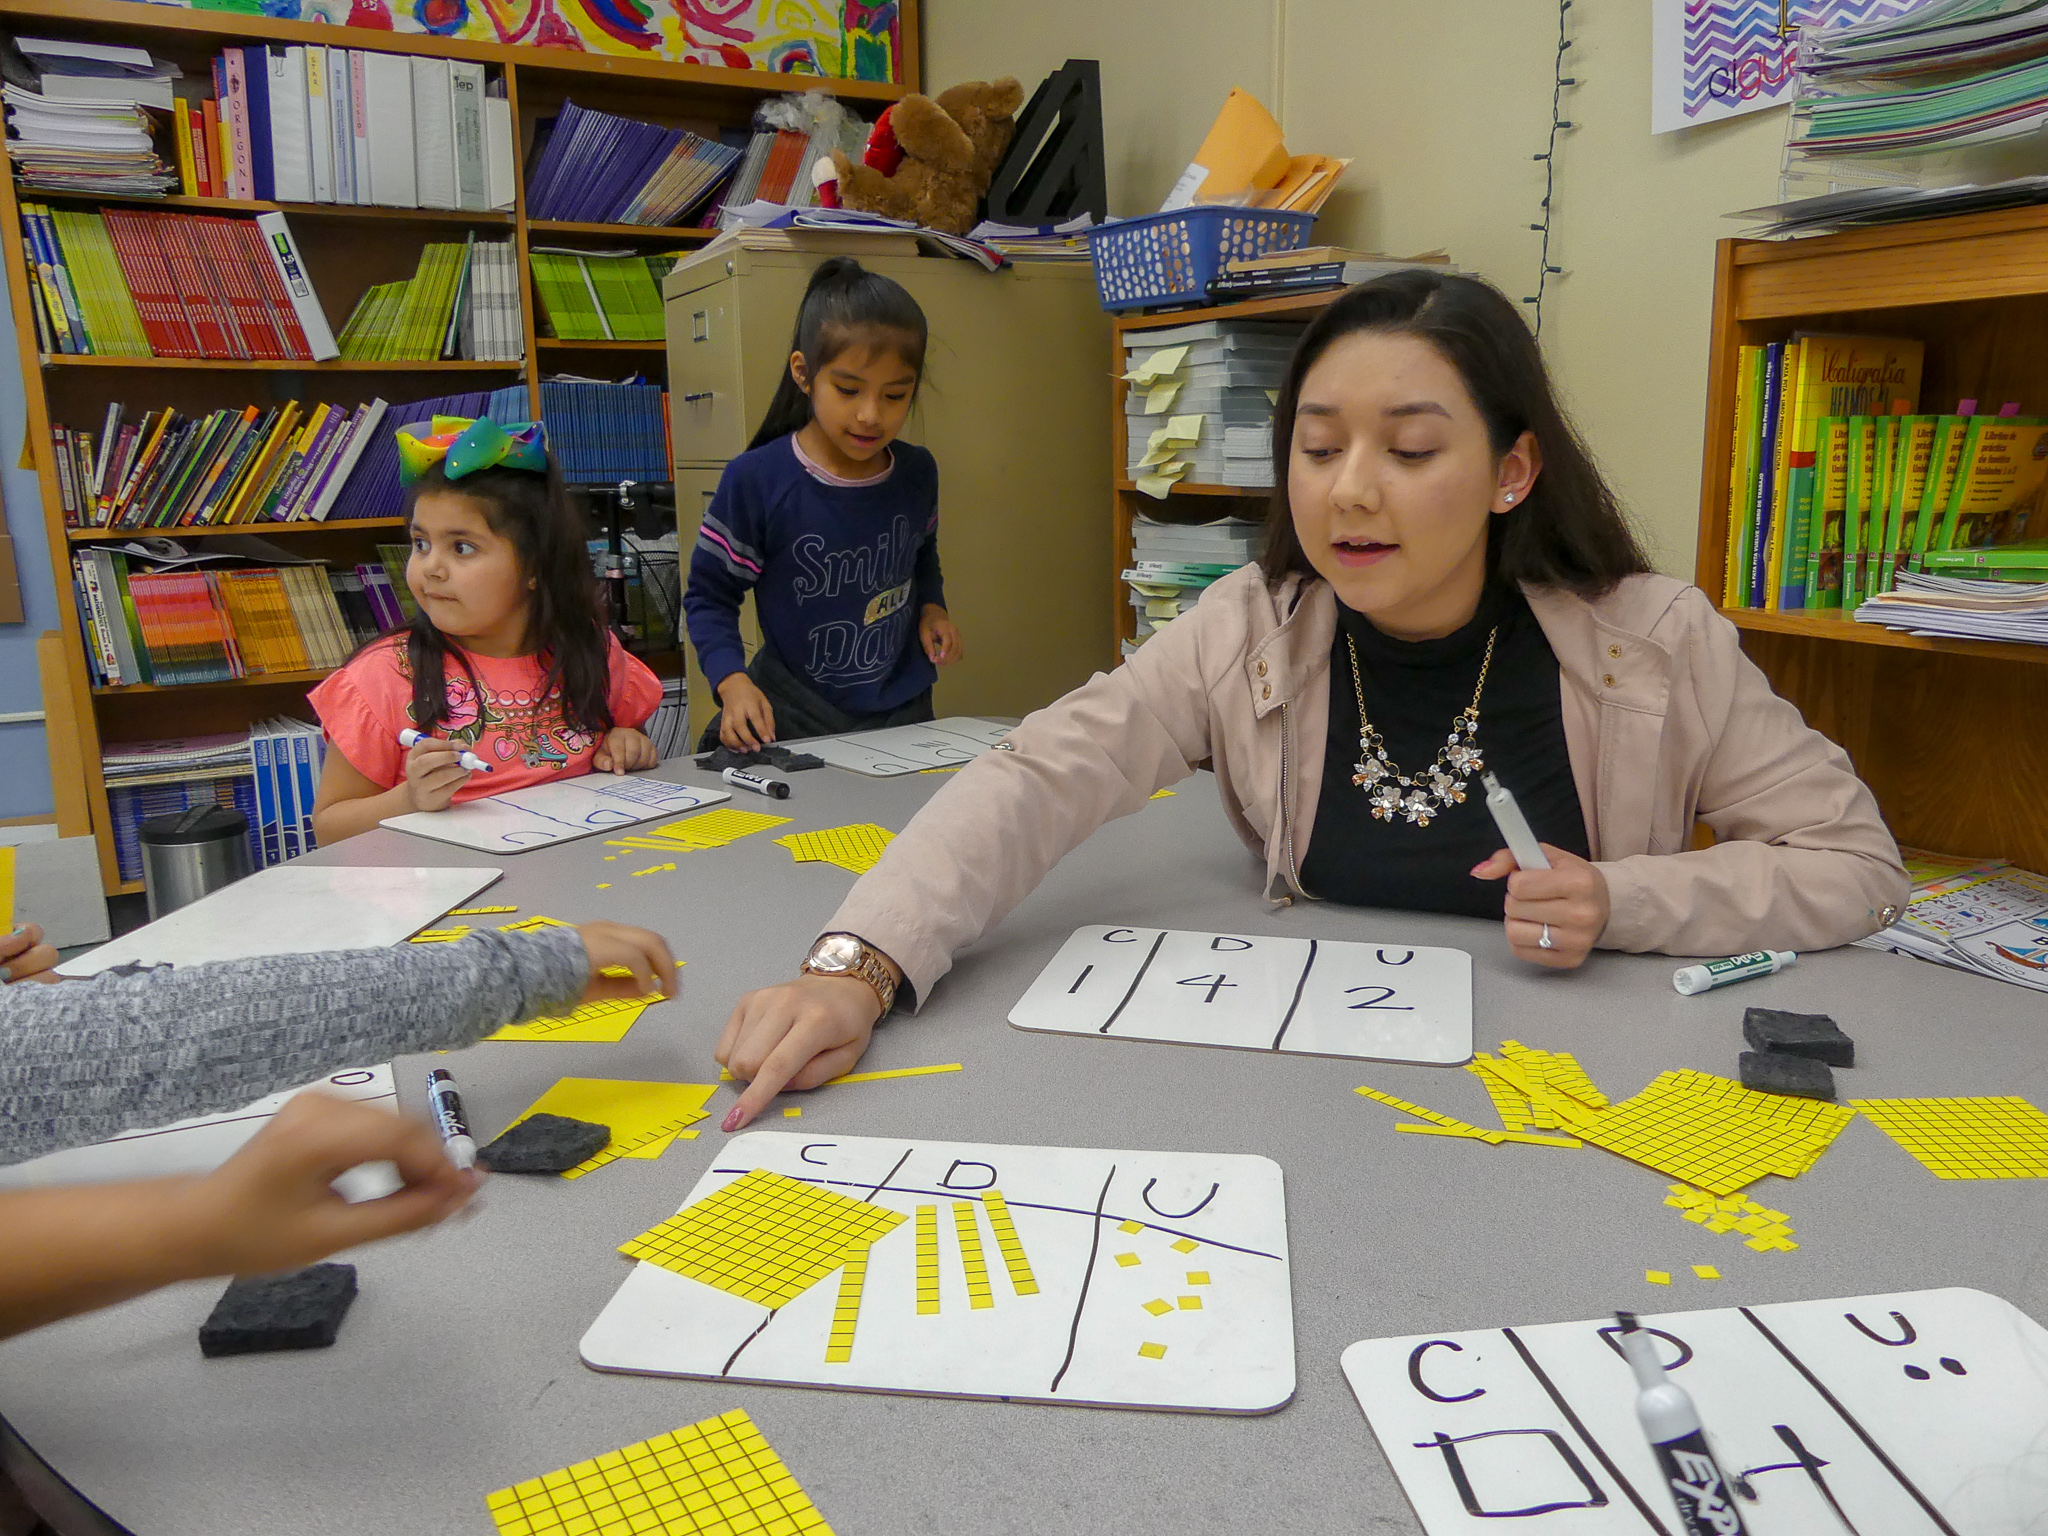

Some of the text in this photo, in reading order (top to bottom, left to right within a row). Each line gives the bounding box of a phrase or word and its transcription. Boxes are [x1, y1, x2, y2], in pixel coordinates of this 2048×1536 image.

[233, 100, 248, 178] OREGON
[1102, 928, 1415, 966] C D U
[1980, 953, 2026, 975] barco
[1067, 964, 1415, 1011] 1 4 2
[799, 1143, 1220, 1219] C D U
[1406, 1339, 1487, 1403] C
[1843, 1310, 1918, 1347] U
[1670, 1449, 1741, 1536] EXP
